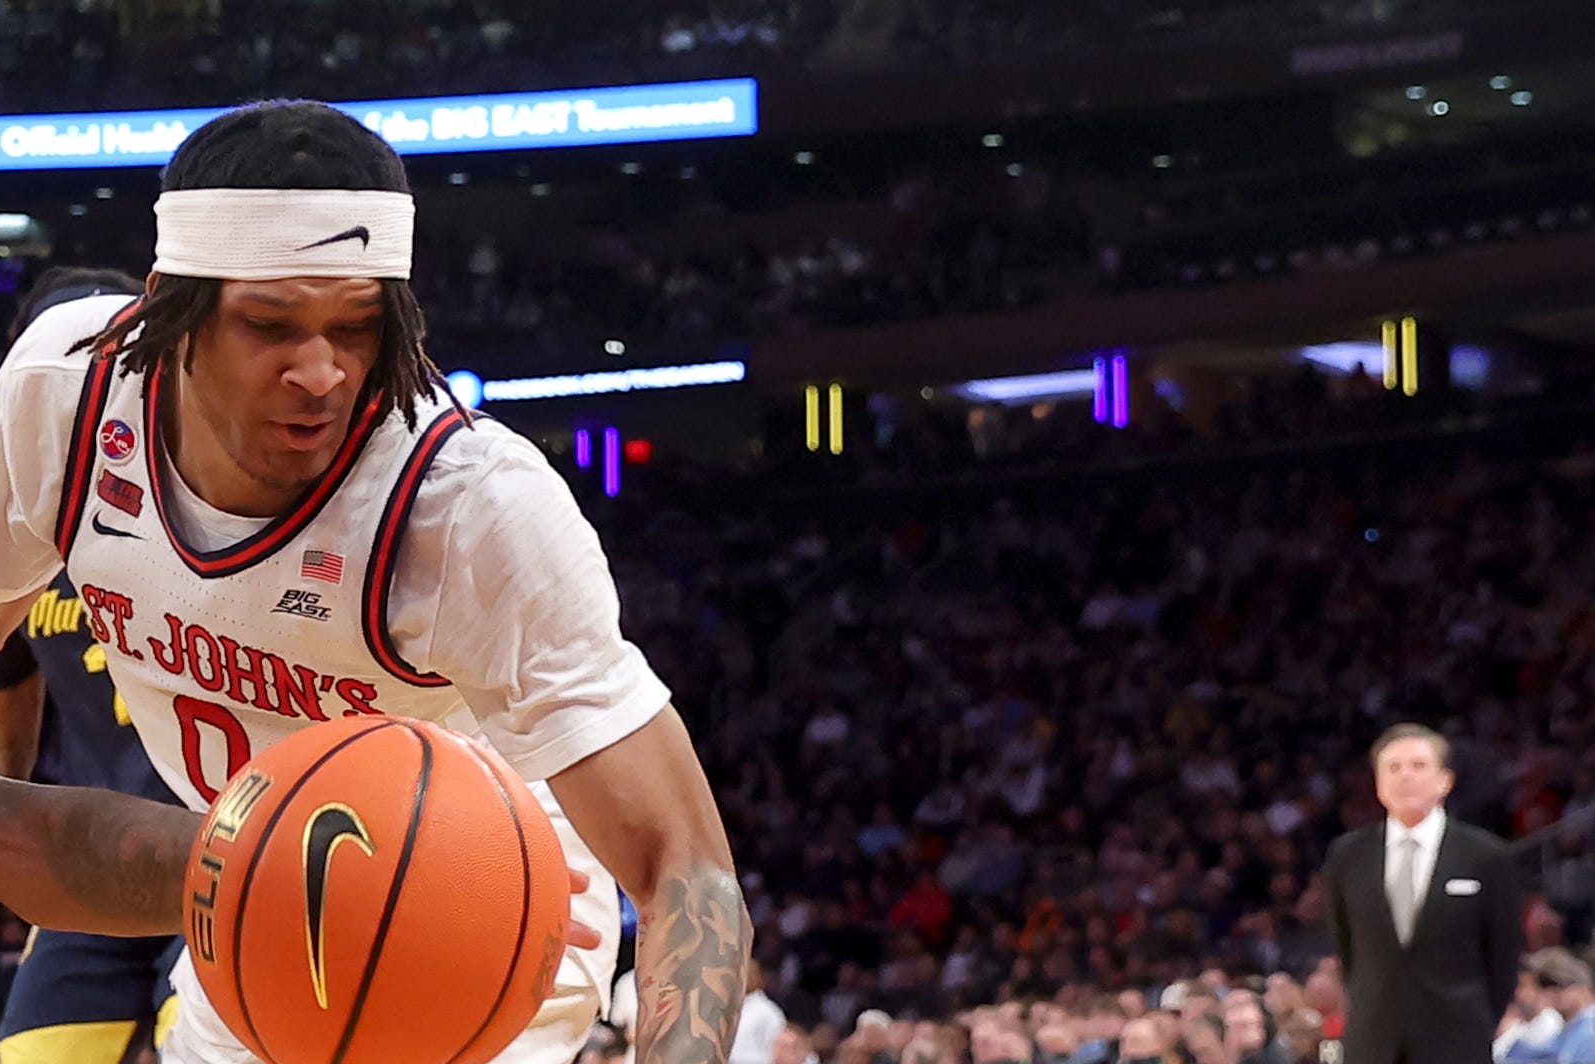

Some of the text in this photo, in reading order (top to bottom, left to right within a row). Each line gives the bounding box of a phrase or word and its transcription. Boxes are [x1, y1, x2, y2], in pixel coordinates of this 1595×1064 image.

[492, 101, 571, 137] EAST
[276, 599, 332, 618] EAST
[282, 589, 322, 605] BIG
[81, 583, 144, 660] ST.
[147, 613, 386, 721] JOHN'S
[172, 694, 251, 807] 0
[190, 768, 275, 966] ELITE
